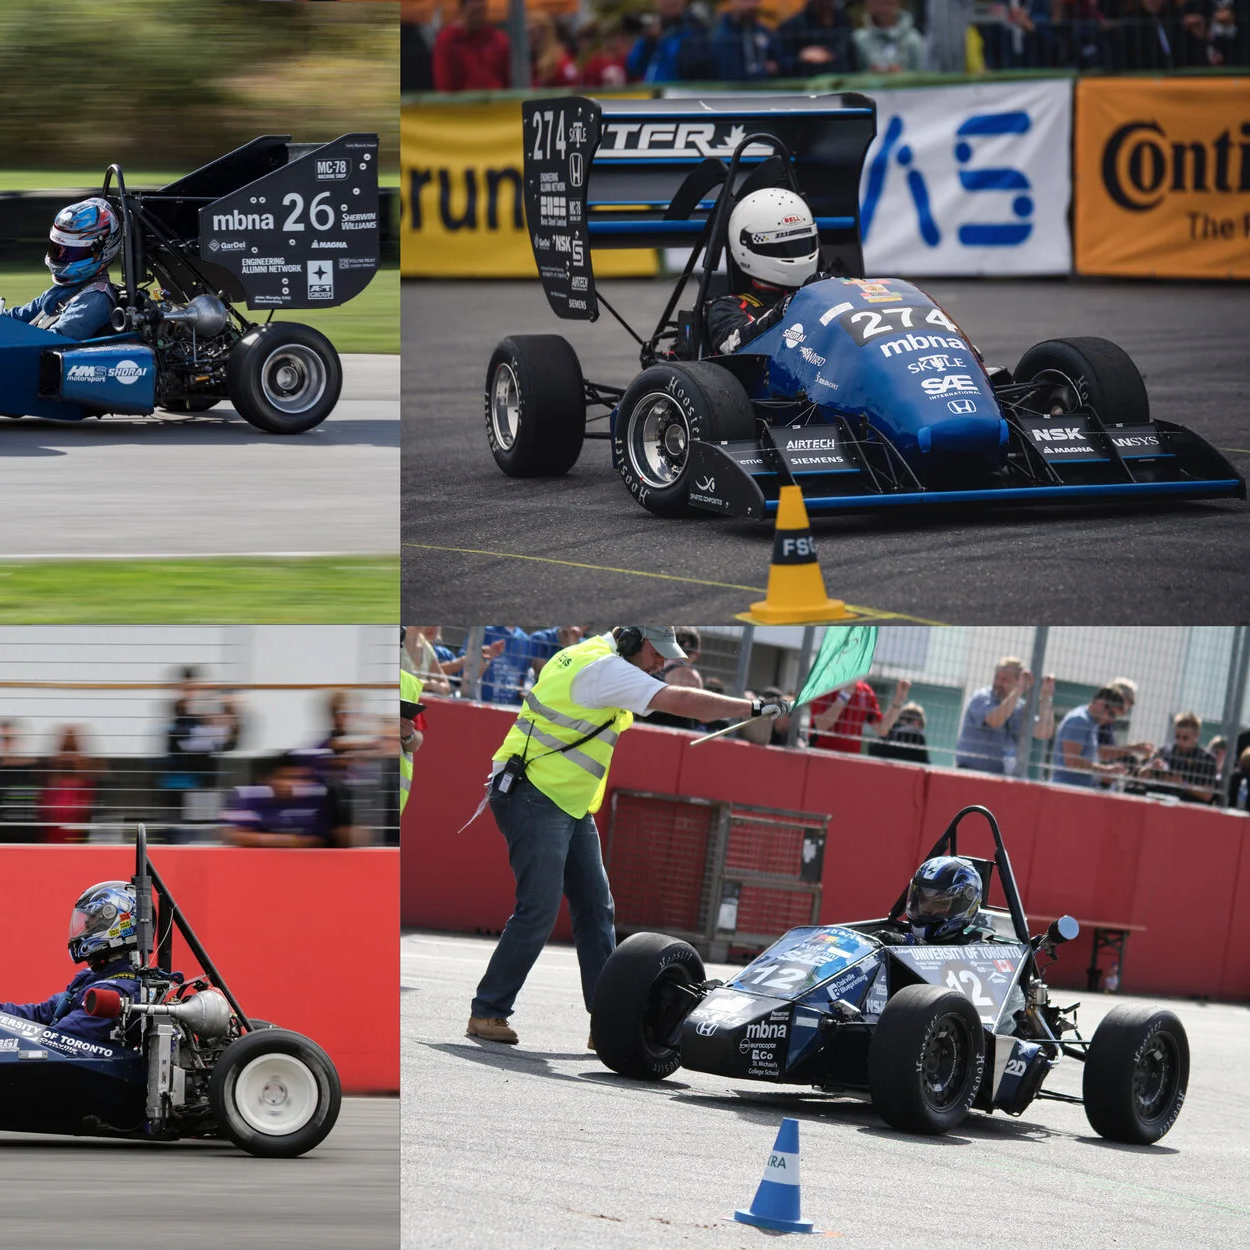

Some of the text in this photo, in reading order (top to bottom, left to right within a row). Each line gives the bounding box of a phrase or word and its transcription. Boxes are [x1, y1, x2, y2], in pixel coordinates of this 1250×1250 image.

[533, 110, 567, 160] 274
[317, 160, 347, 174] MC-78
[282, 191, 335, 231] 26
[341, 213, 377, 222] SHERWIN
[213, 209, 274, 231] mbna
[341, 221, 377, 230] WILLIAMS
[784, 216, 801, 224] BELL
[1187, 212, 1236, 241] The
[555, 235, 572, 253] NSK
[241, 257, 285, 266] ENGINEERING
[241, 264, 302, 274] ALUMNI NETWORK
[569, 299, 587, 310] SIEMENS
[851, 307, 957, 339] 274
[880, 334, 966, 358] mbna
[67, 365, 107, 378] HMS
[108, 367, 147, 377] SHORAI
[67, 375, 106, 383] motorsport
[921, 375, 978, 395] SAE
[929, 390, 982, 400] INTERNATIONAL
[1031, 427, 1086, 442] NSK
[786, 438, 835, 450] AIRTECH
[1054, 446, 1094, 454] MAGNA
[790, 456, 844, 465] SIEMENS
[910, 946, 1022, 960] UNIVERSITY OF TORONTO
[751, 964, 807, 990] 12
[836, 972, 856, 989] Oakville
[839, 973, 869, 996] Blueprinting
[945, 970, 994, 1007] 12
[746, 1020, 787, 1039] mbna
[42, 1030, 59, 1042] OF
[61, 1034, 113, 1057] TORONTO
[759, 1060, 778, 1068] Michael's
[1004, 1059, 1027, 1077] 2D
[748, 1068, 780, 1077] College School
